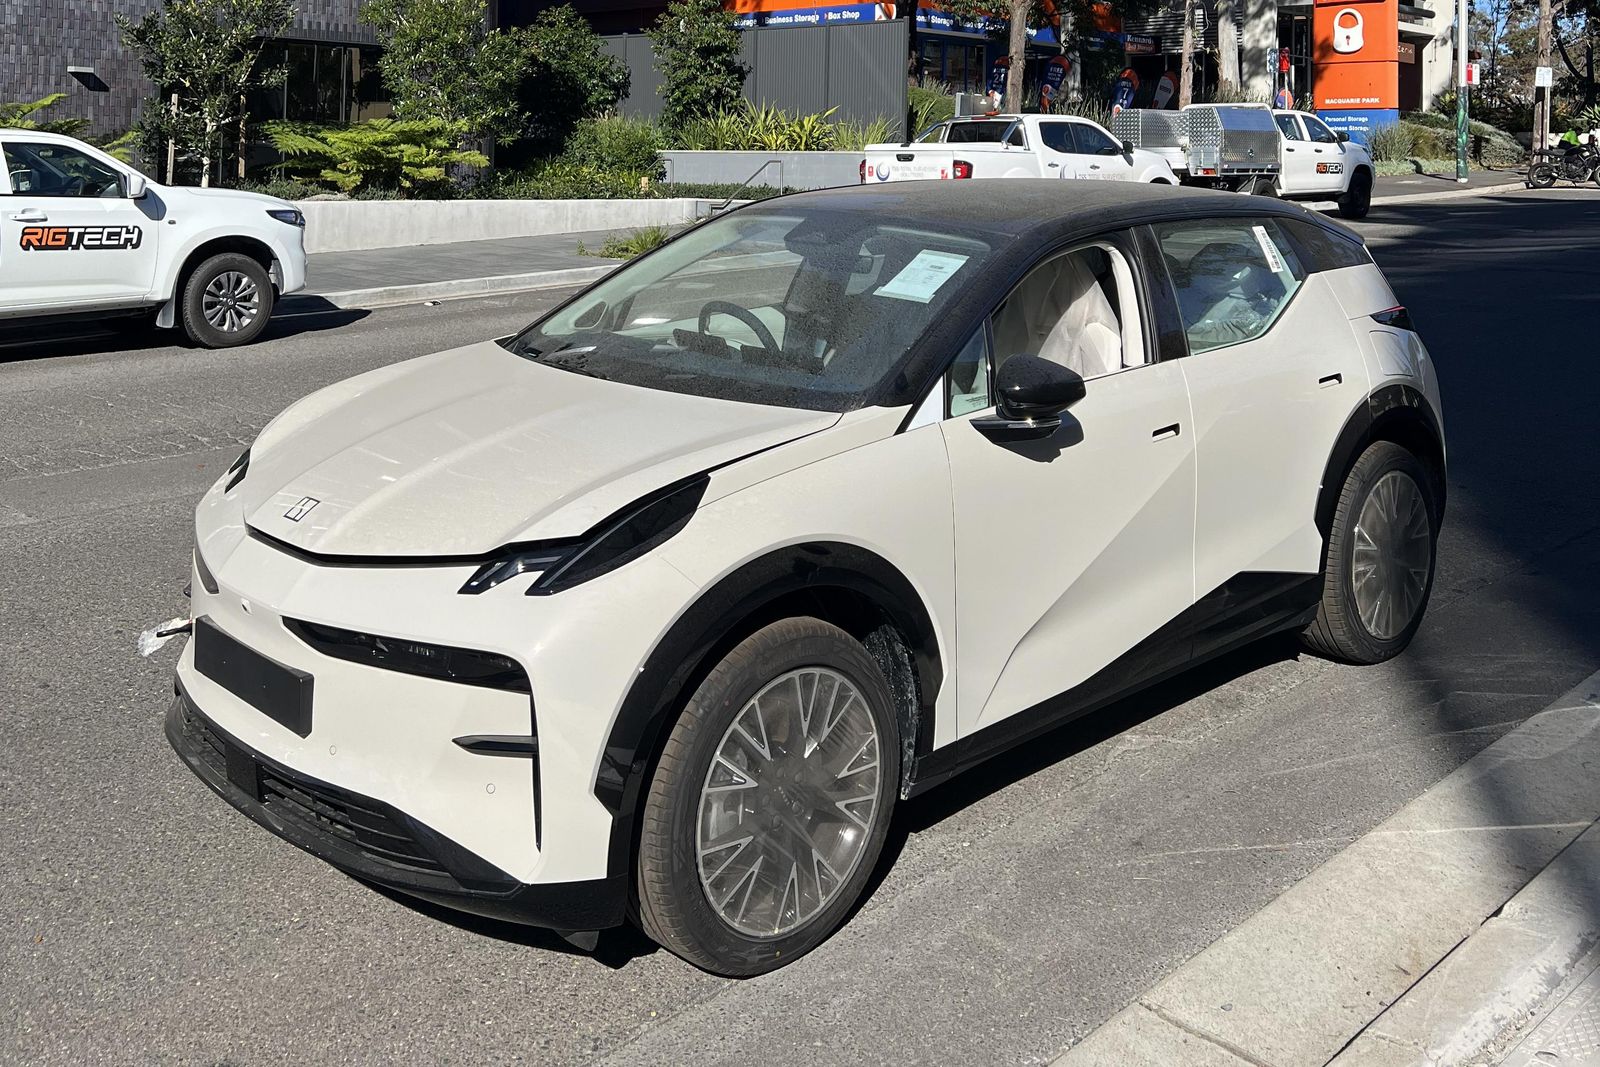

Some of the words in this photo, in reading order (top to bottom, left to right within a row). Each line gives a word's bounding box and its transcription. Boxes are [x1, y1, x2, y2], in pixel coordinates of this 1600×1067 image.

[764, 15, 793, 24] Business
[794, 14, 819, 24] Storage
[828, 11, 841, 20] Box
[842, 10, 860, 20] Shop
[931, 15, 954, 27] Storage
[1050, 66, 1063, 74] FREE
[1122, 88, 1129, 99] 7
[1316, 162, 1343, 174] RIGTECH
[21, 226, 140, 249] RIGTECH
